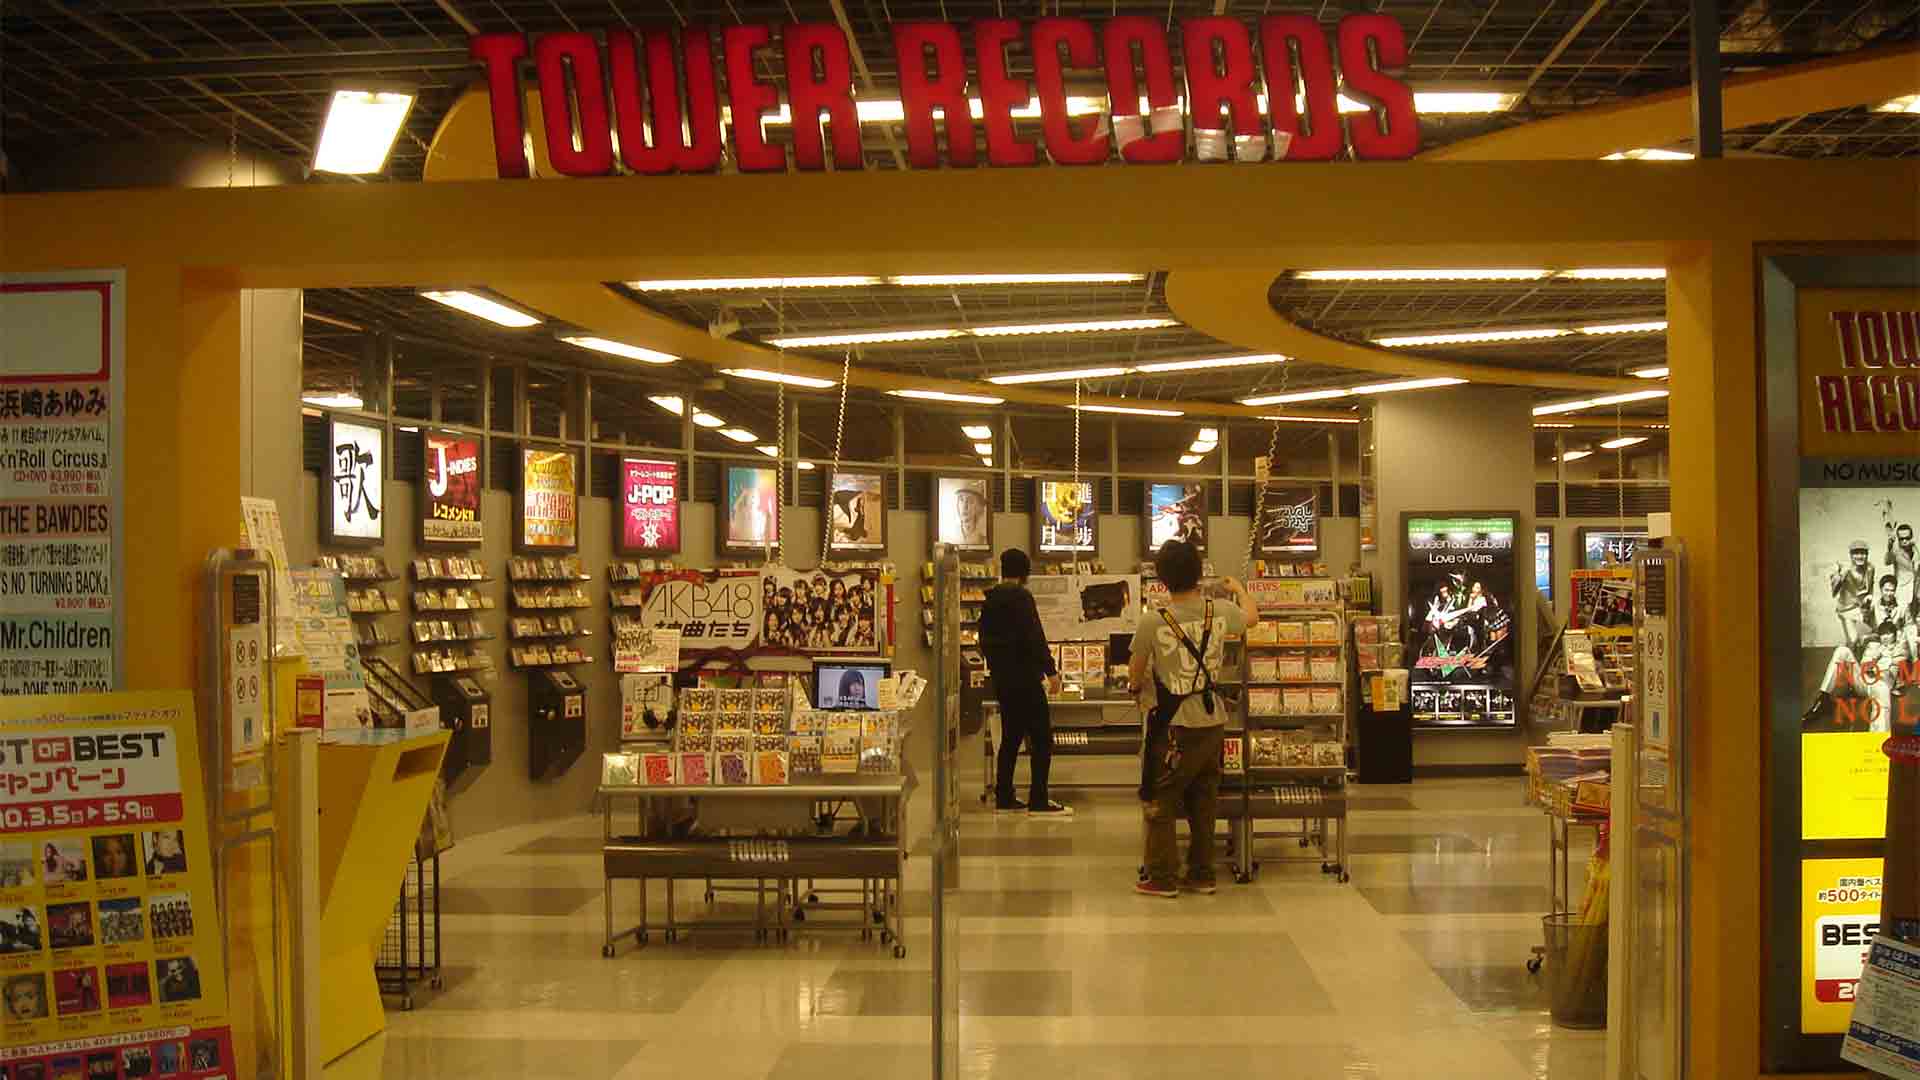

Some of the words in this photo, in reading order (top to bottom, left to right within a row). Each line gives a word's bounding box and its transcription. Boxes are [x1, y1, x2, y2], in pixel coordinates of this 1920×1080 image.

[470, 23, 864, 179] TOWER
[893, 15, 1420, 168] RECORDS
[1814, 374, 1920, 433] RECO
[333, 440, 382, 523] 歌
[1823, 463, 1854, 481] NO
[627, 484, 674, 505] J-POP
[0, 504, 30, 534] THE
[37, 504, 108, 534] BAWDIES
[1429, 552, 1456, 564] Love
[1464, 552, 1494, 564] Wars
[12, 571, 26, 594] NO
[29, 570, 73, 594] TURNING
[646, 582, 753, 619] AKB48
[1, 619, 110, 649] Mr.Children
[73, 732, 166, 761] BEST
